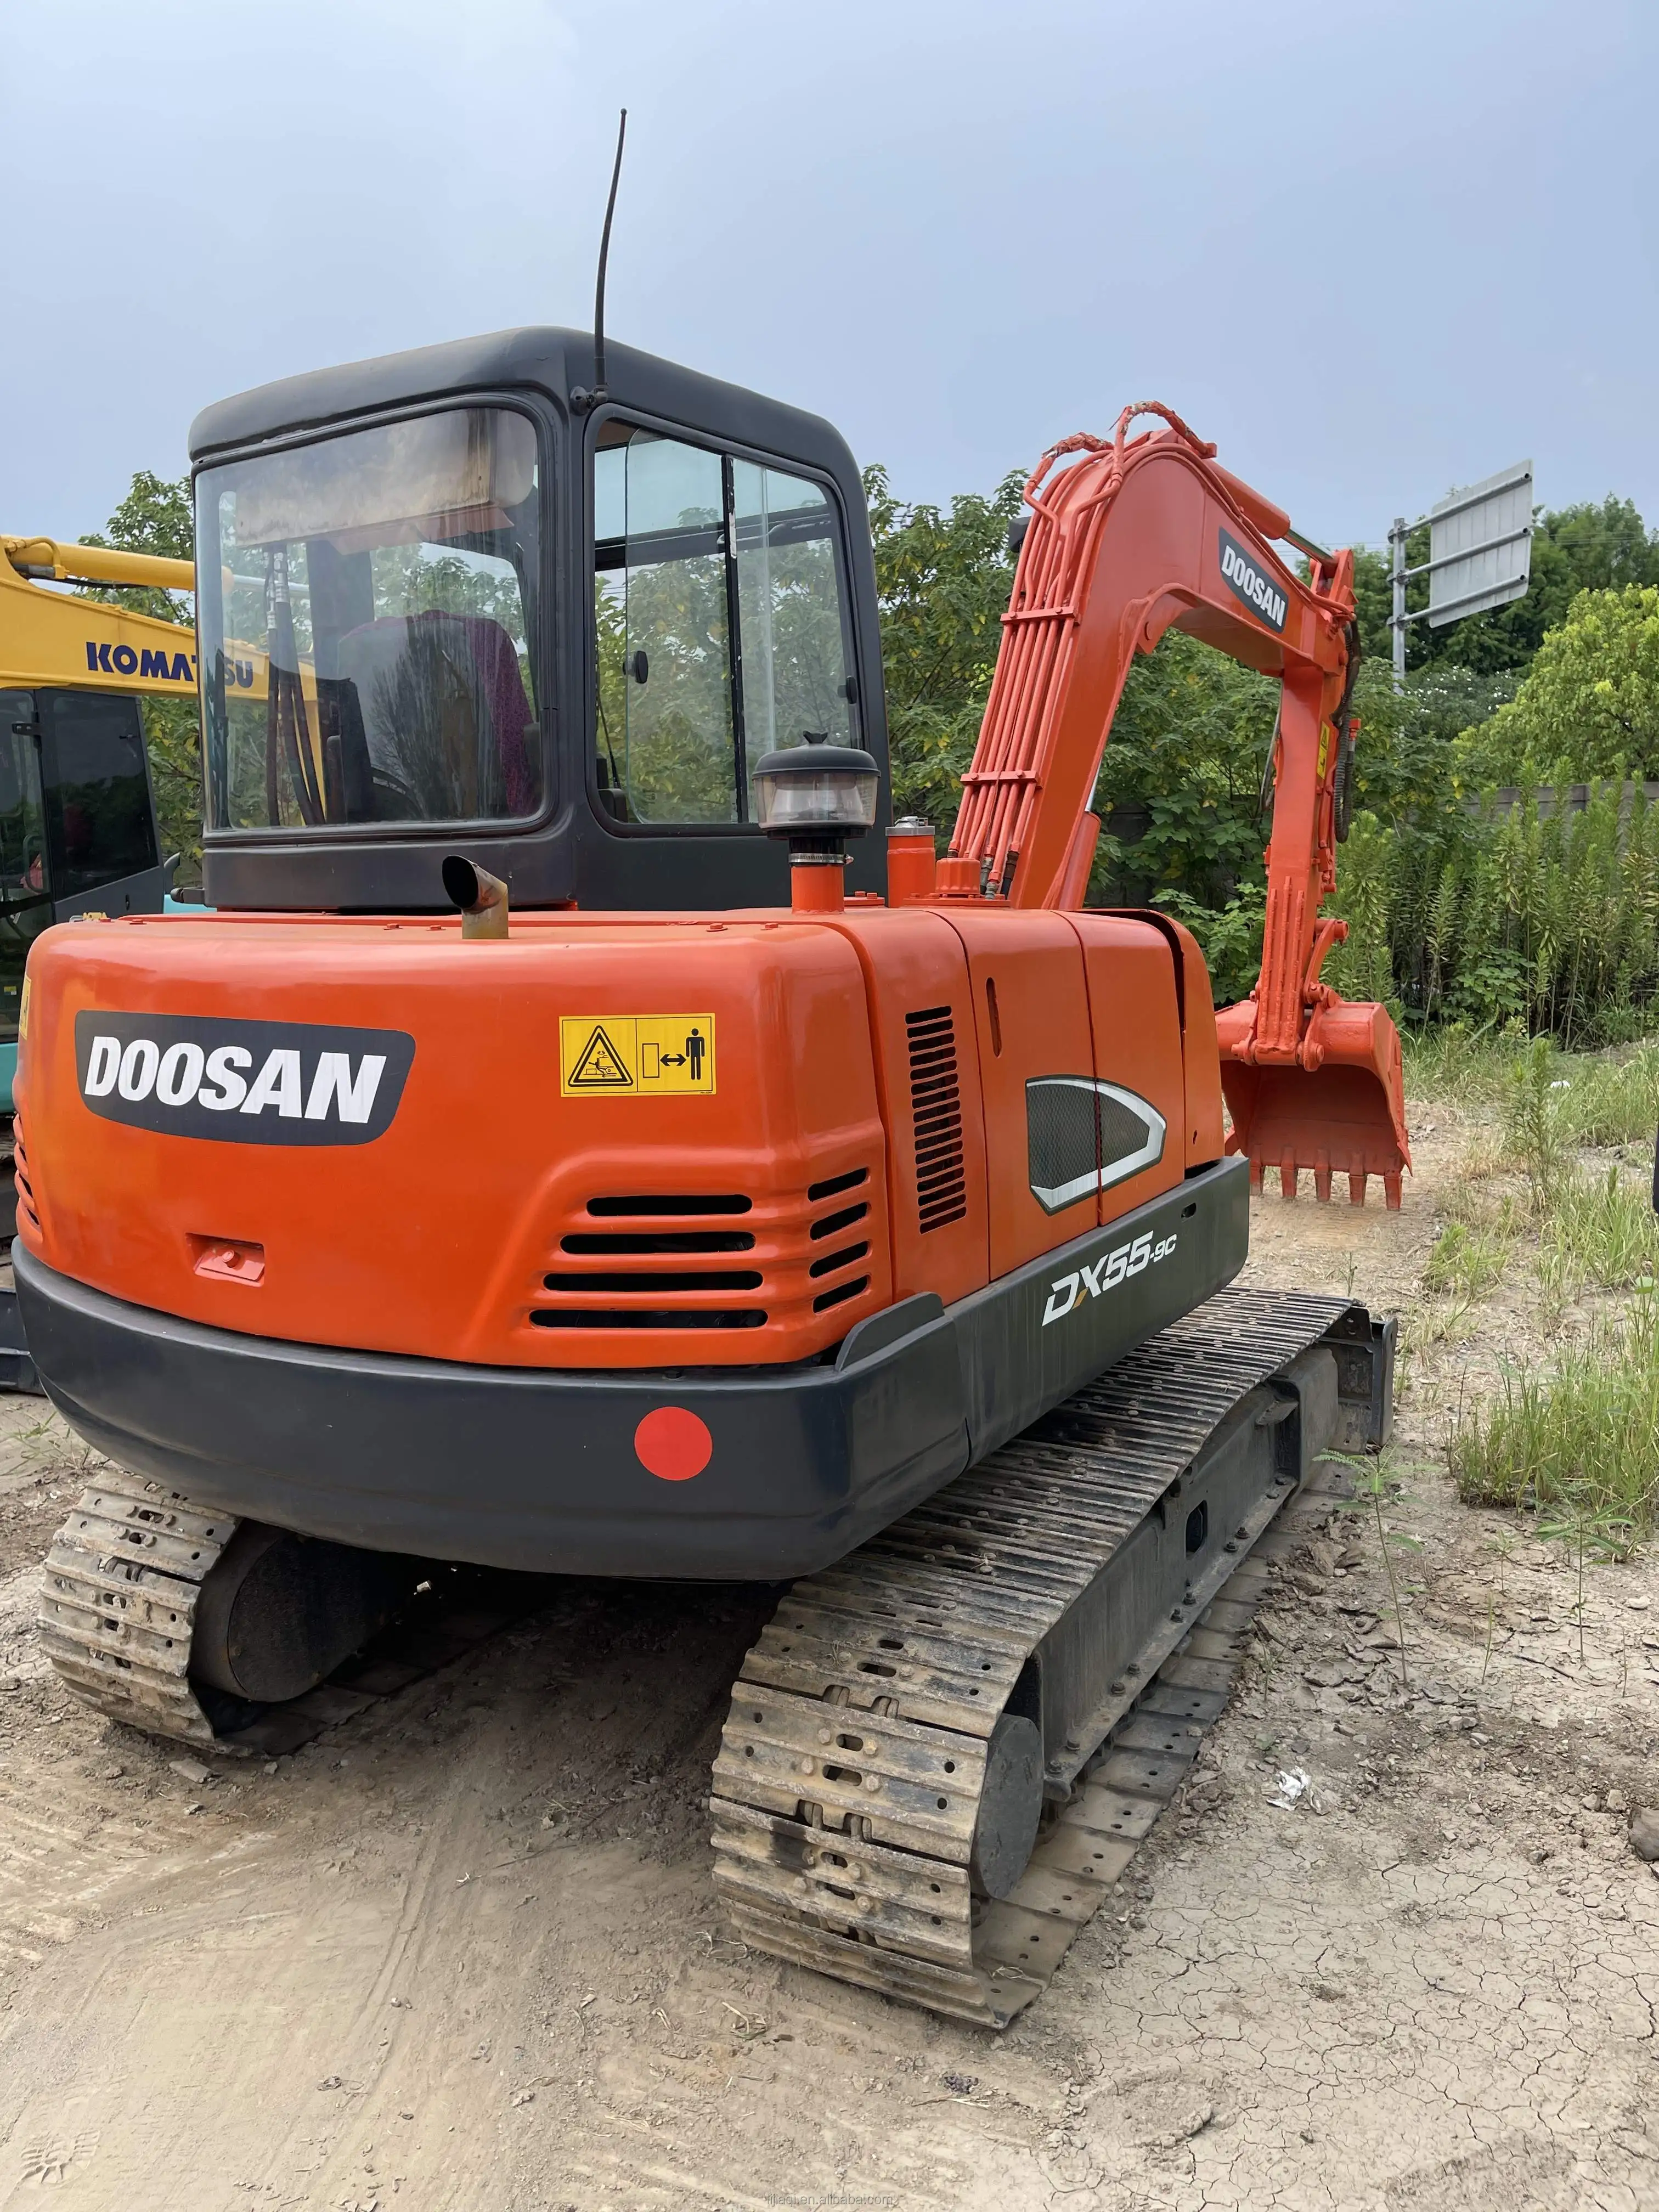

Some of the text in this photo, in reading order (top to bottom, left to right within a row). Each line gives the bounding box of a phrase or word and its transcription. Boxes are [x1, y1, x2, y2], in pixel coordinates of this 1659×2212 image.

[1221, 545, 1285, 627] DOOSAN
[86, 641, 253, 689] KOMASU
[84, 1036, 387, 1124] DOOSAN
[1042, 1230, 1177, 1327] DX55-9C
